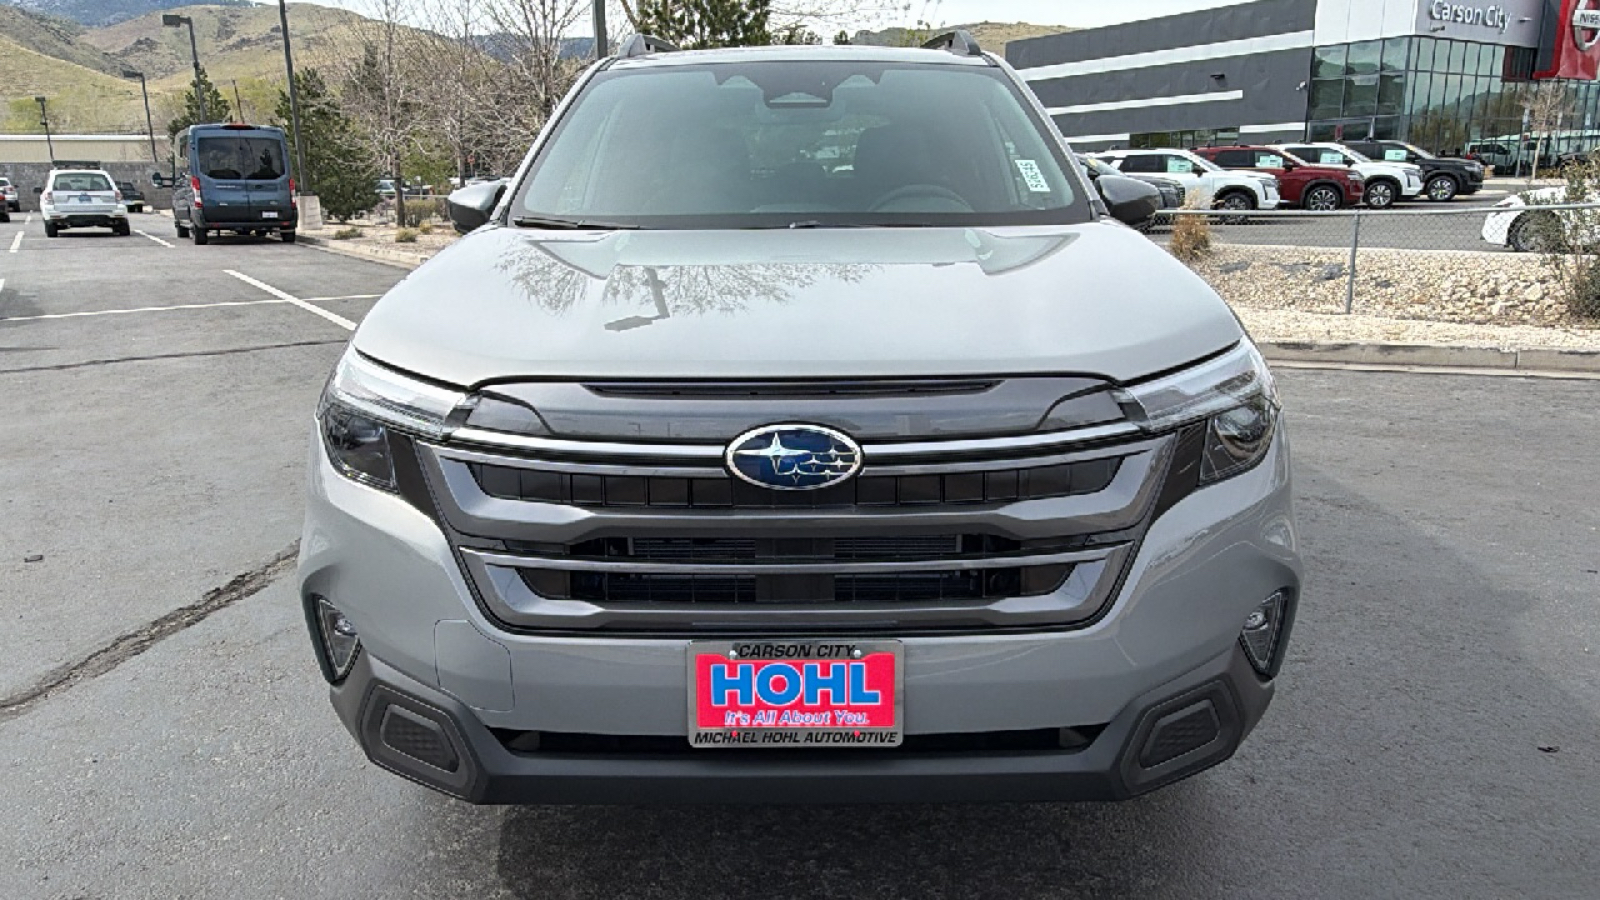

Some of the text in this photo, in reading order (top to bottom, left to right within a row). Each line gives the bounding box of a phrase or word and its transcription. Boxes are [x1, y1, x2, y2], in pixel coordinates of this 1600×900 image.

[1431, 0, 1511, 33] Carson City
[739, 644, 856, 658] CARSON CITY
[711, 663, 880, 706] HOHL
[724, 710, 870, 725] It's All About You.
[694, 732, 898, 744] MICHAEL HOHL AUTOMOTIVE
